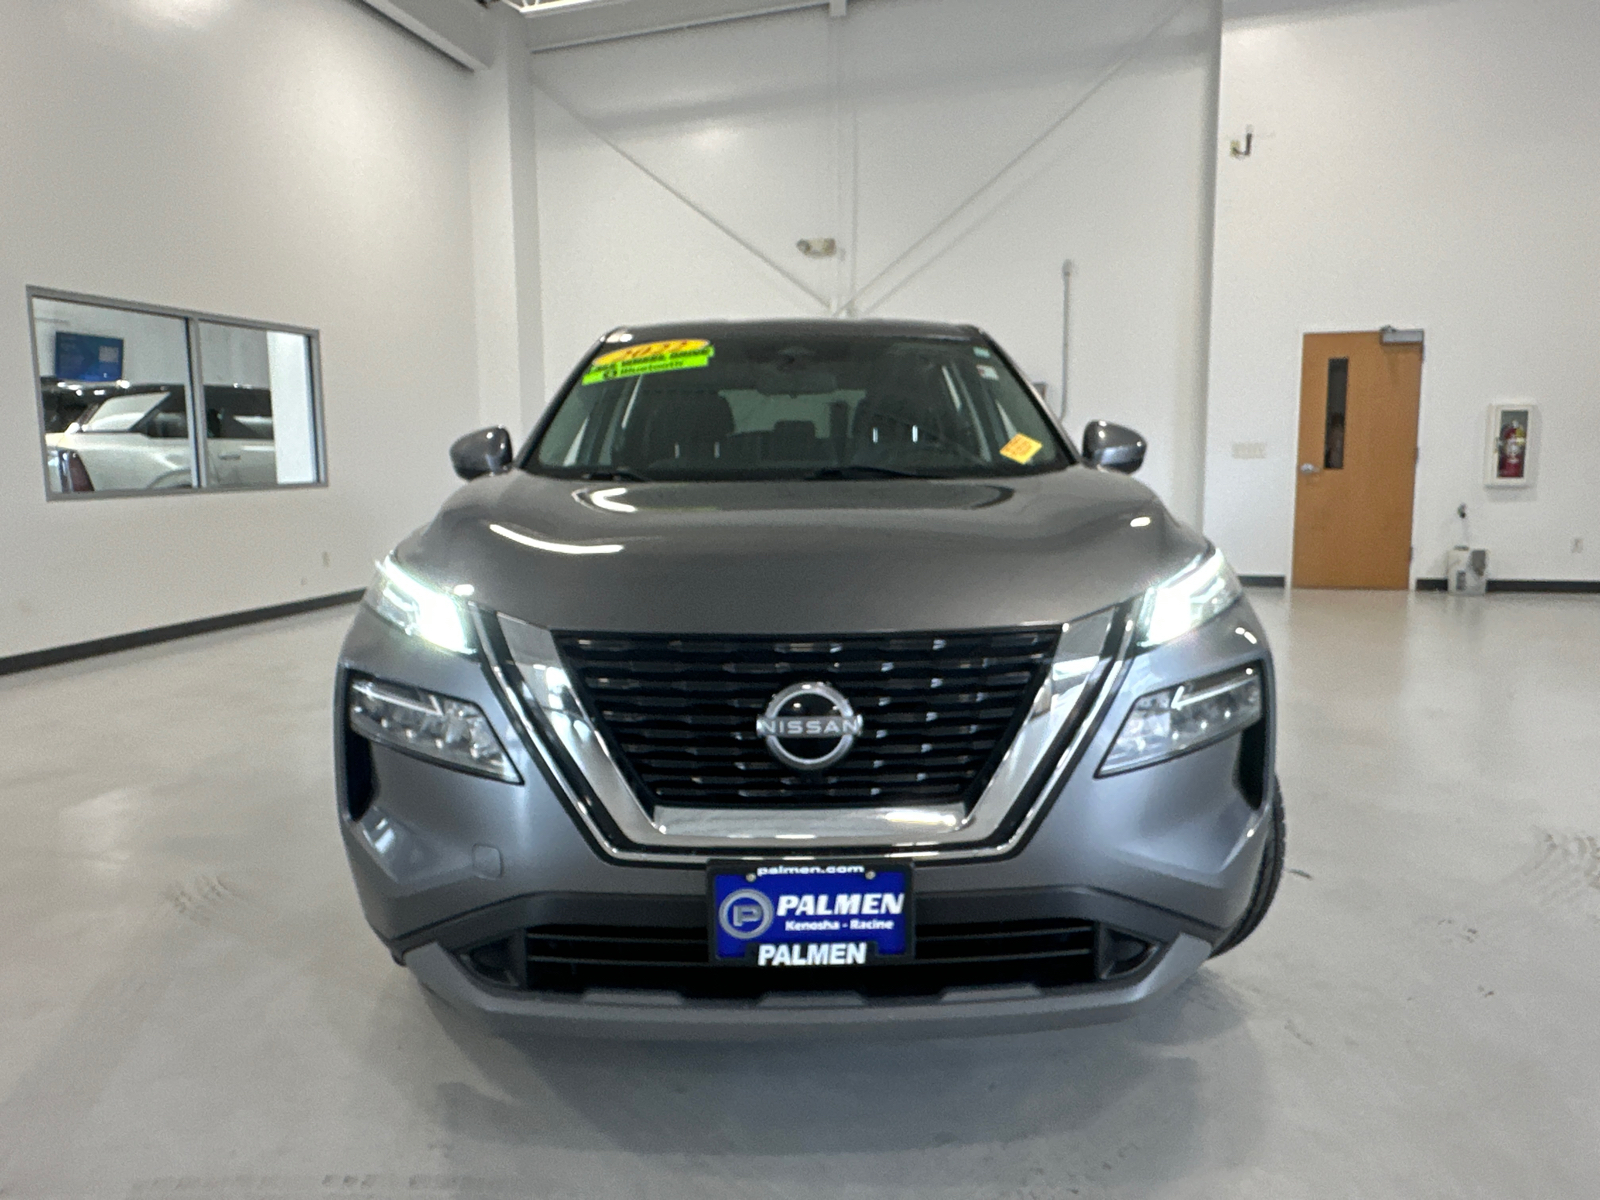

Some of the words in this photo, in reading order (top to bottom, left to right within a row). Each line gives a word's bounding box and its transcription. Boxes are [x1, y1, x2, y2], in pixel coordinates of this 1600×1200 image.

[759, 720, 858, 734] NISSAN
[757, 865, 865, 877] palmen.com
[776, 893, 905, 916] PALMEN
[785, 920, 840, 931] Kenosha
[850, 918, 894, 930] Racine
[757, 942, 867, 966] PALMEN
